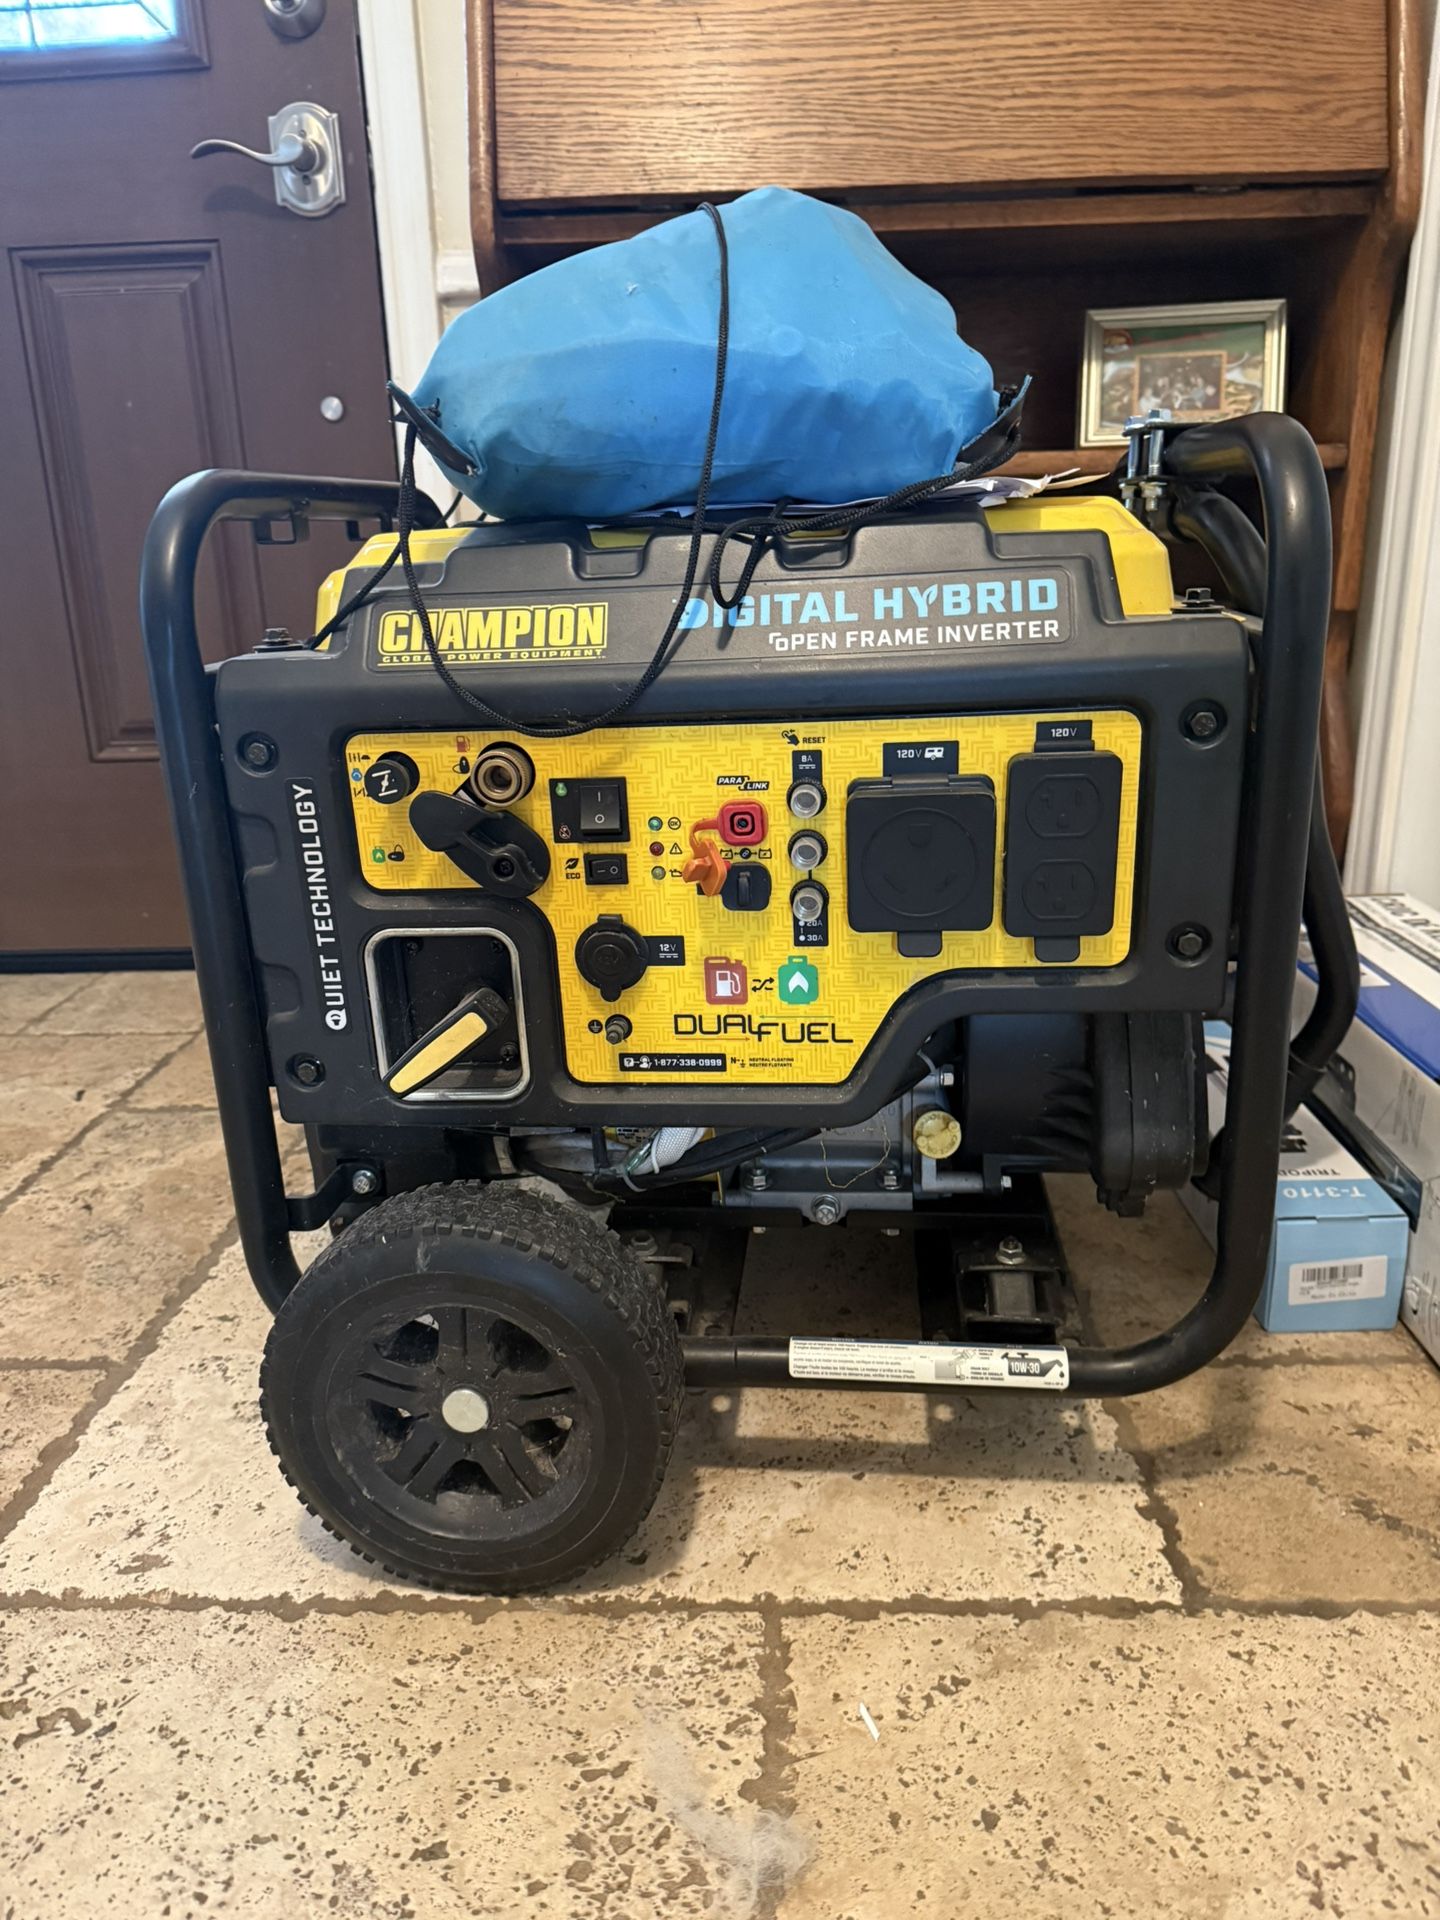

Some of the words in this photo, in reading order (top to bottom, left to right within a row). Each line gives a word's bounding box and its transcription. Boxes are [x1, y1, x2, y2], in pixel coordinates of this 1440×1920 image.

[672, 589, 859, 631] DIGITAL
[873, 578, 1059, 620] HYBRID
[768, 630, 837, 652] OPEN
[845, 627, 929, 649] FRAME
[937, 619, 1060, 645] INVERTER
[382, 653, 436, 663] GLOBA
[447, 651, 503, 662] POWER
[509, 648, 603, 660] EQUIPMENT
[1050, 727, 1077, 738] 120V
[802, 736, 826, 744] RESET
[801, 755, 813, 763] 8A
[896, 748, 922, 759] 120V
[718, 777, 743, 785] PARA
[746, 782, 768, 790] LINK
[292, 784, 335, 947] TECHNOLOGY
[565, 872, 581, 880] ECO
[806, 934, 824, 942] 30A
[659, 943, 677, 952] 12V
[319, 954, 347, 1031] QUIET
[1282, 1185, 1367, 1200] T-3110
[1010, 1361, 1040, 1374] 10W-30
